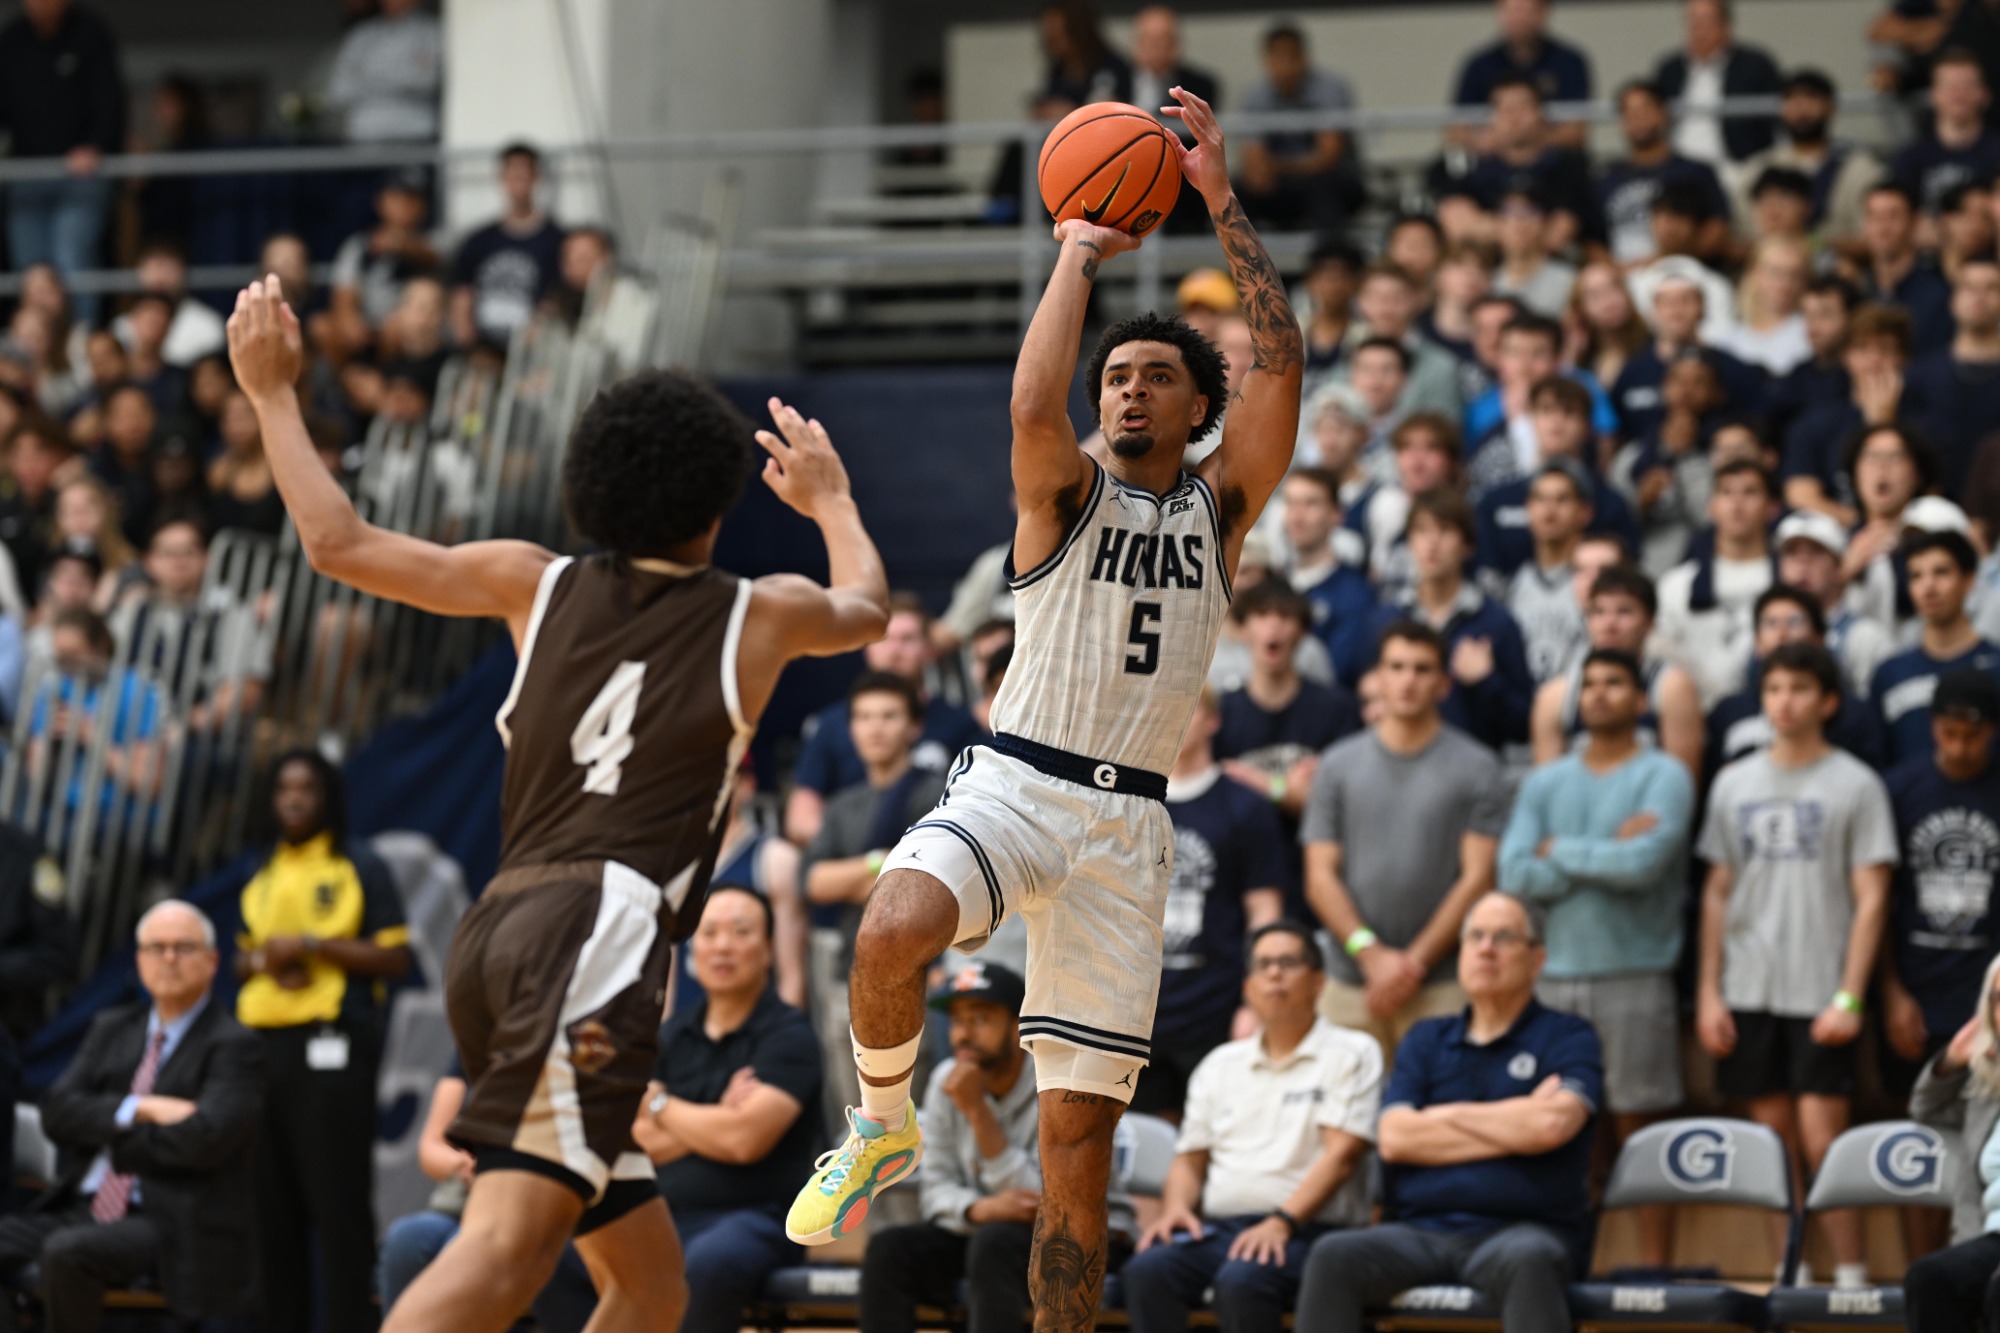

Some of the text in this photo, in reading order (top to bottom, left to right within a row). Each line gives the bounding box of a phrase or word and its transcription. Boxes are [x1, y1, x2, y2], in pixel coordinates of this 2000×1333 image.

[1169, 502, 1196, 513] EAST
[1170, 498, 1188, 509] BIG
[1090, 526, 1203, 589] HOYAS
[1124, 601, 1162, 676] 5
[570, 660, 648, 796] 4
[1093, 763, 1118, 789] G
[1062, 1089, 1098, 1105] Love
[1663, 1126, 1732, 1189] G
[1872, 1127, 1942, 1192] G
